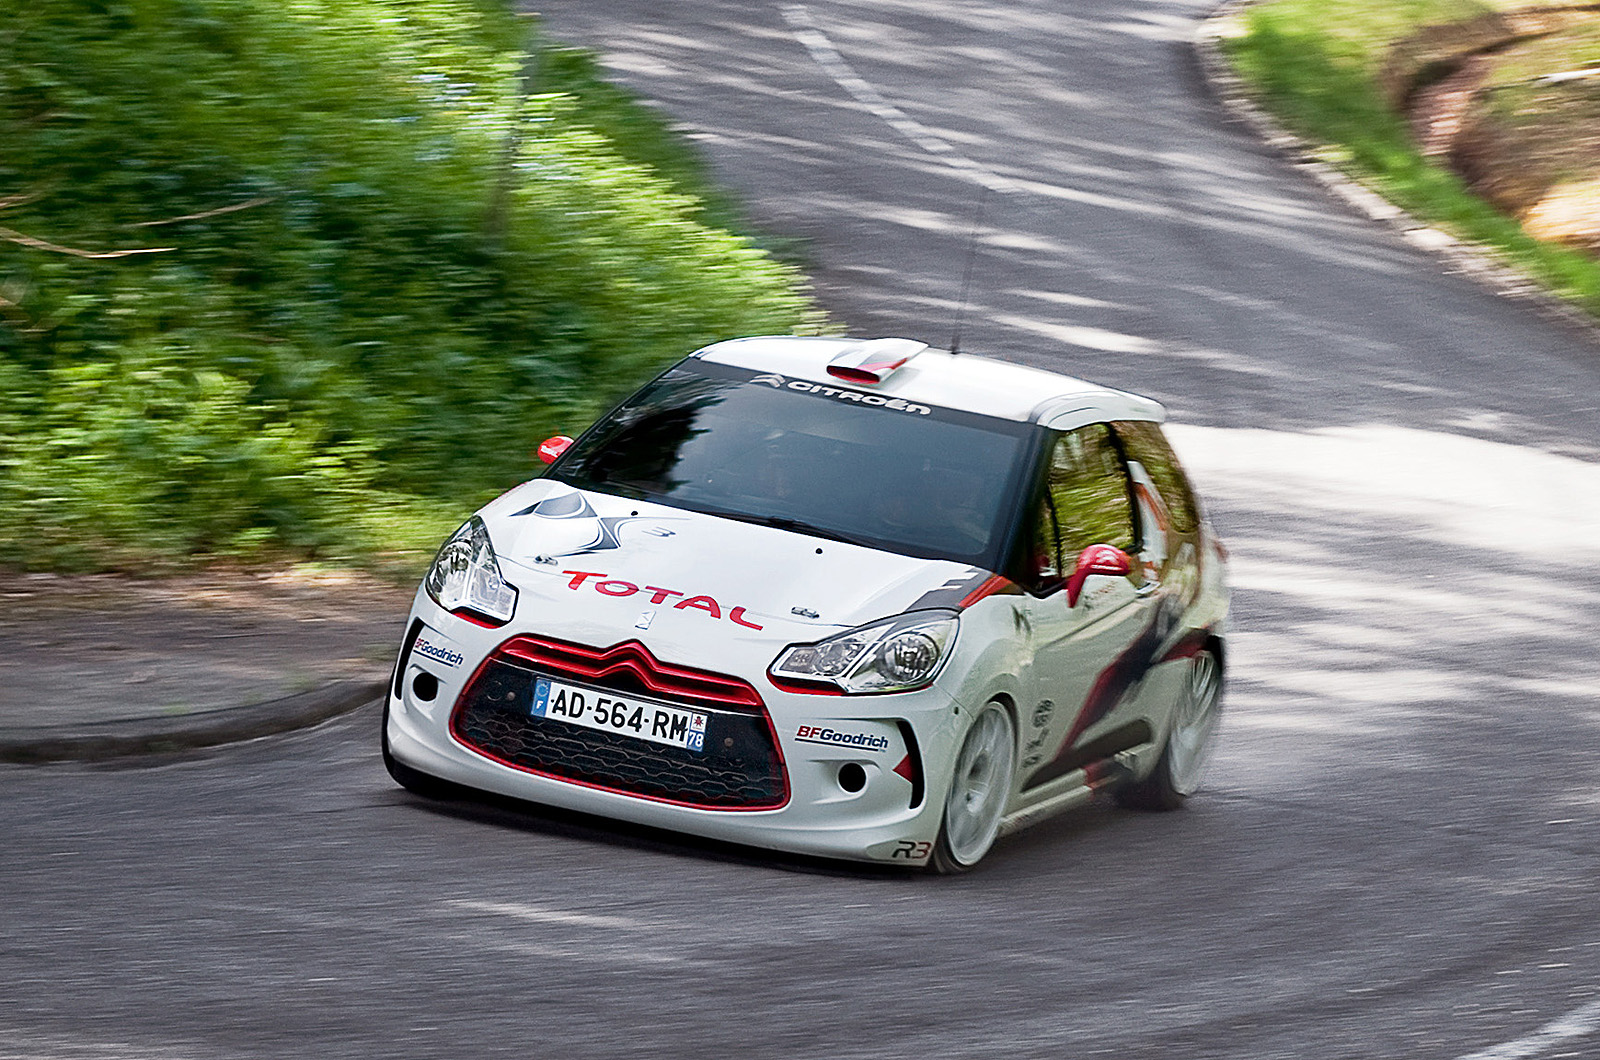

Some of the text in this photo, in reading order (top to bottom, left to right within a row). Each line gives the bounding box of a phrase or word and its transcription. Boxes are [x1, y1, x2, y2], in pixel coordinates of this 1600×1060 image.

[562, 570, 764, 631] TOTAL
[536, 700, 543, 709] F
[688, 731, 704, 747] 78
[796, 725, 889, 749] BFGoodrich
[892, 841, 932, 859] R3
